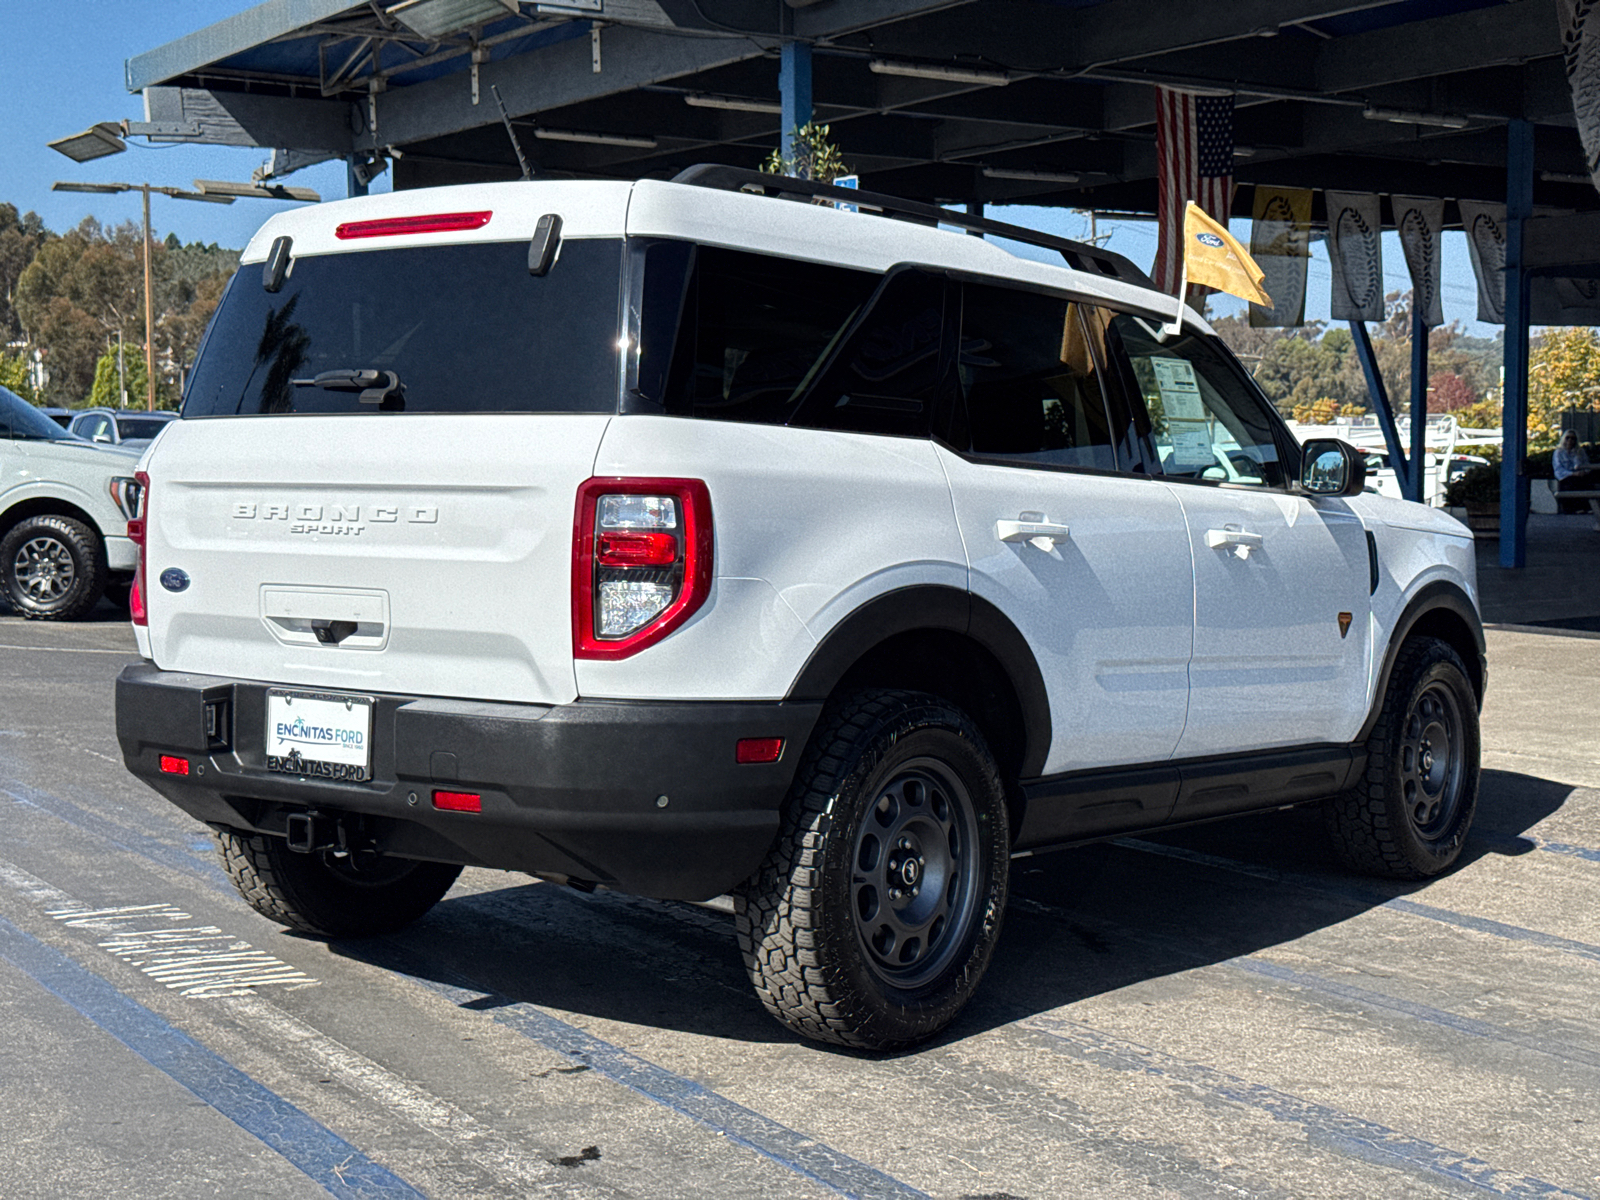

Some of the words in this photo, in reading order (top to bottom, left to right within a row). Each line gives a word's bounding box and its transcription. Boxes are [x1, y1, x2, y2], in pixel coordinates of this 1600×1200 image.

[1200, 234, 1220, 246] Ford
[232, 502, 438, 524] BRONCO
[290, 524, 365, 536] SPORT
[277, 723, 333, 740] ENCINITAS
[335, 729, 363, 744] FORD
[267, 756, 331, 776] ENCINITAS
[333, 763, 365, 780] FORD
